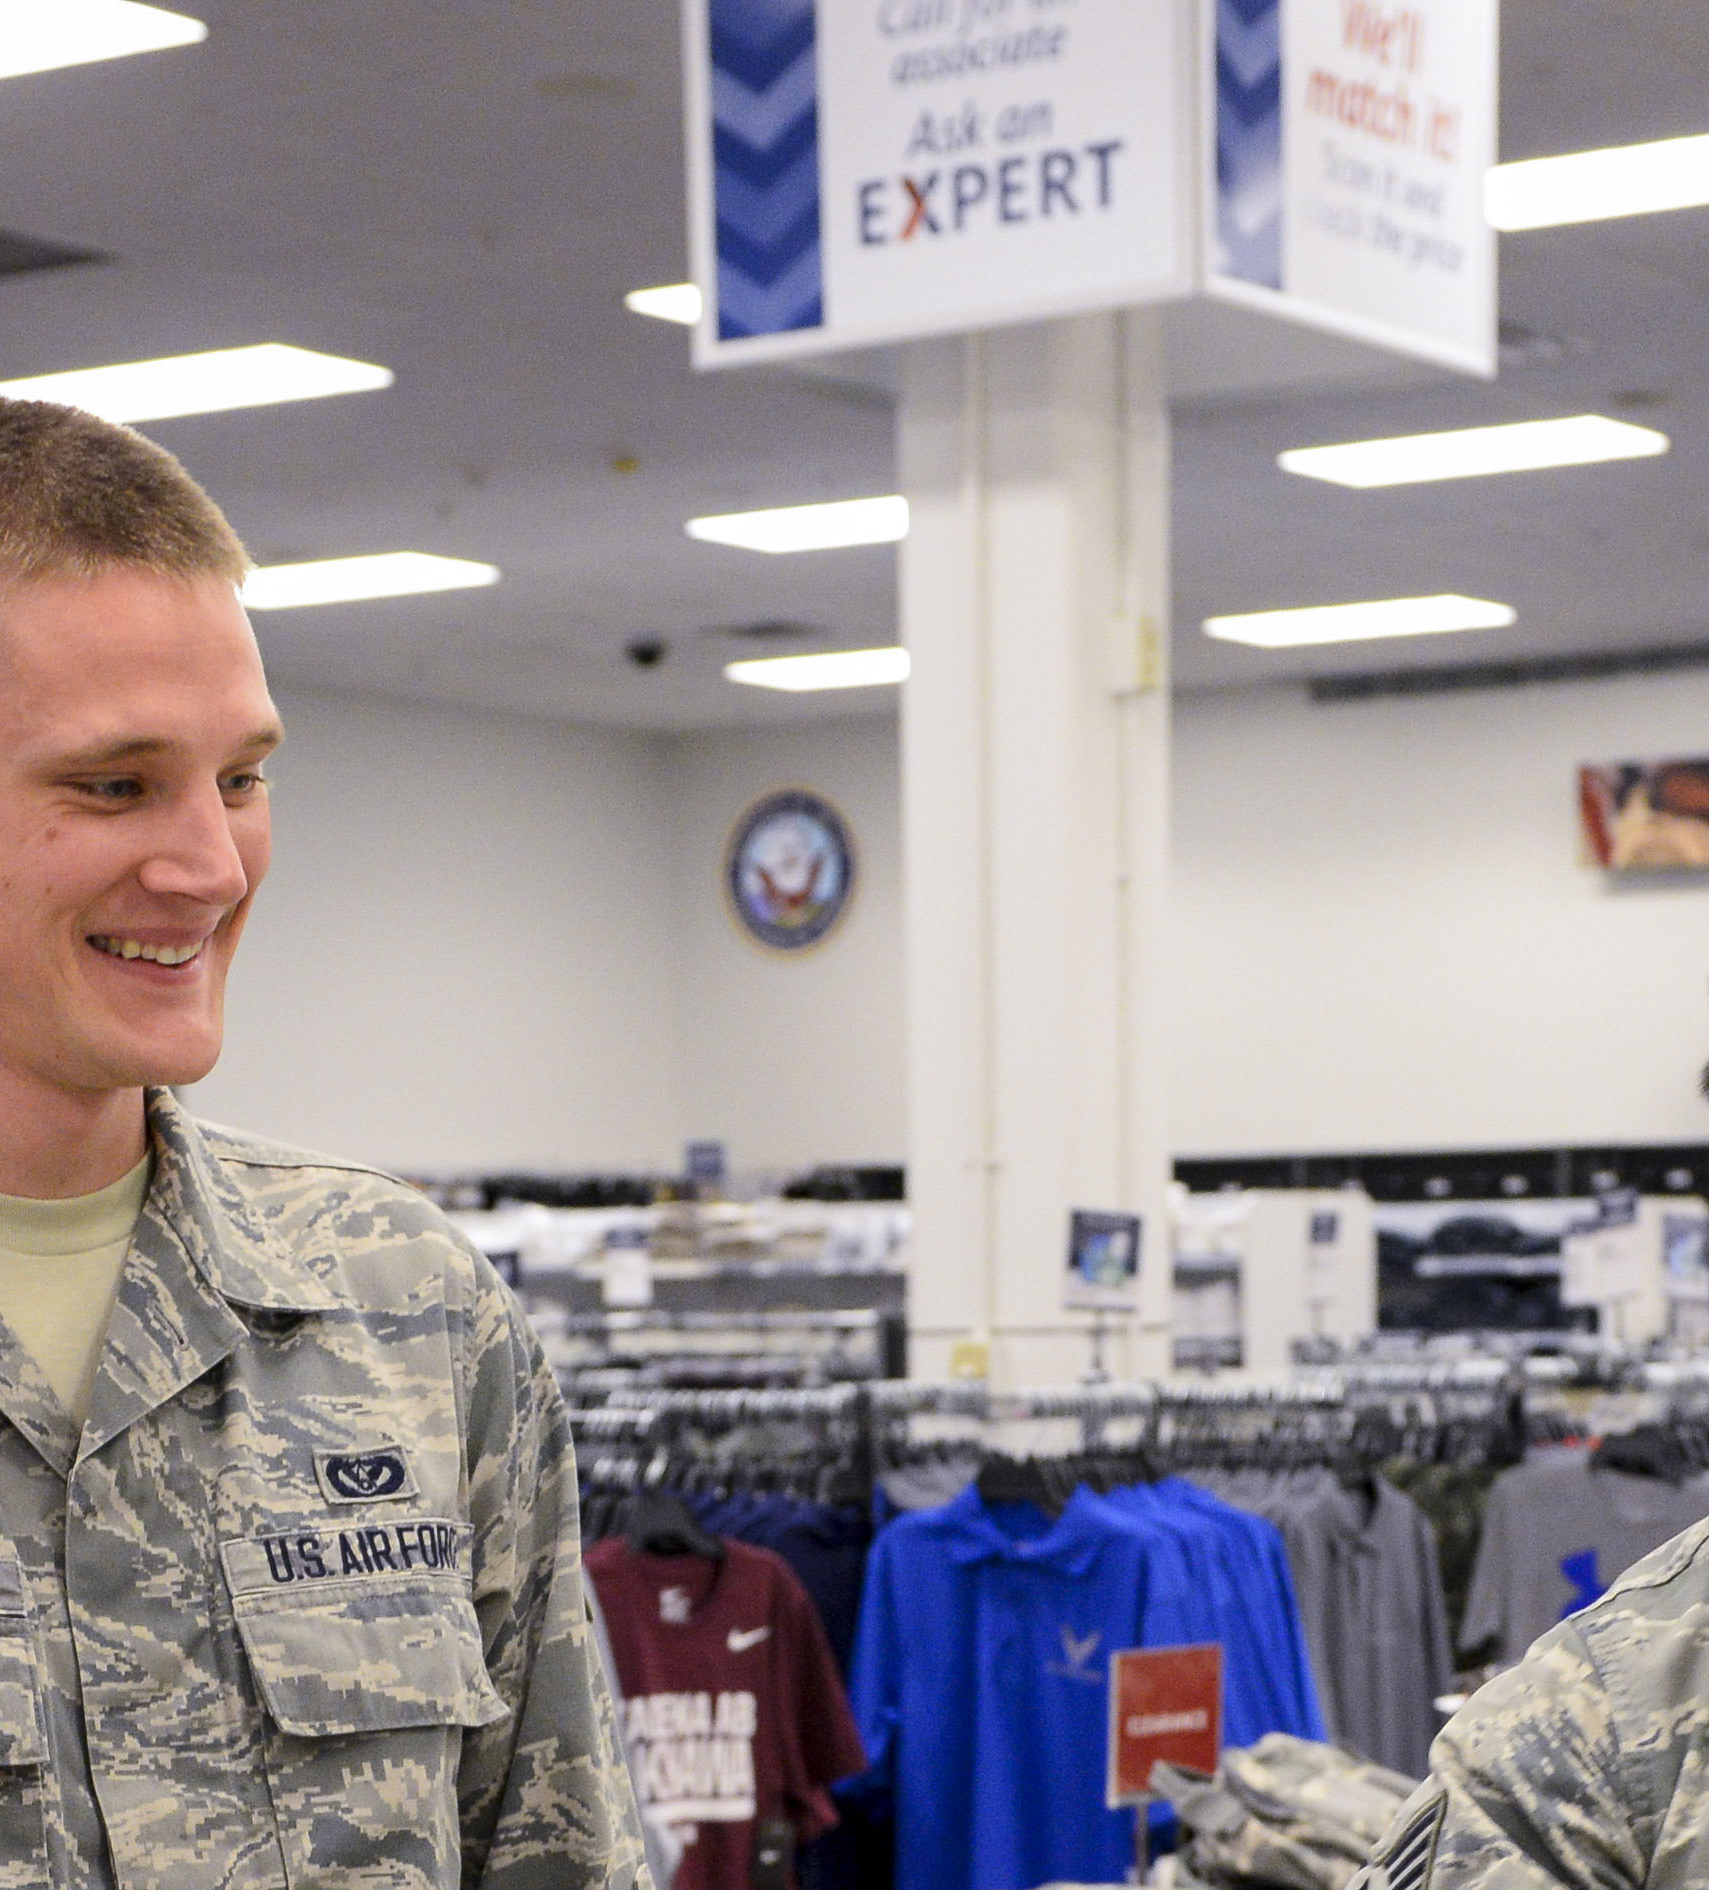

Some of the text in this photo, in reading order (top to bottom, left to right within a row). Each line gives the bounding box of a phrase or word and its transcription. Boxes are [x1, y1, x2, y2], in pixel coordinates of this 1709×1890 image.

[892, 25, 1069, 86] associate
[903, 99, 1053, 157] Ask an
[1304, 67, 1416, 147] match
[857, 139, 1124, 246] EXPERT
[263, 1538, 336, 1584] U.S.
[339, 1528, 398, 1575] AIR
